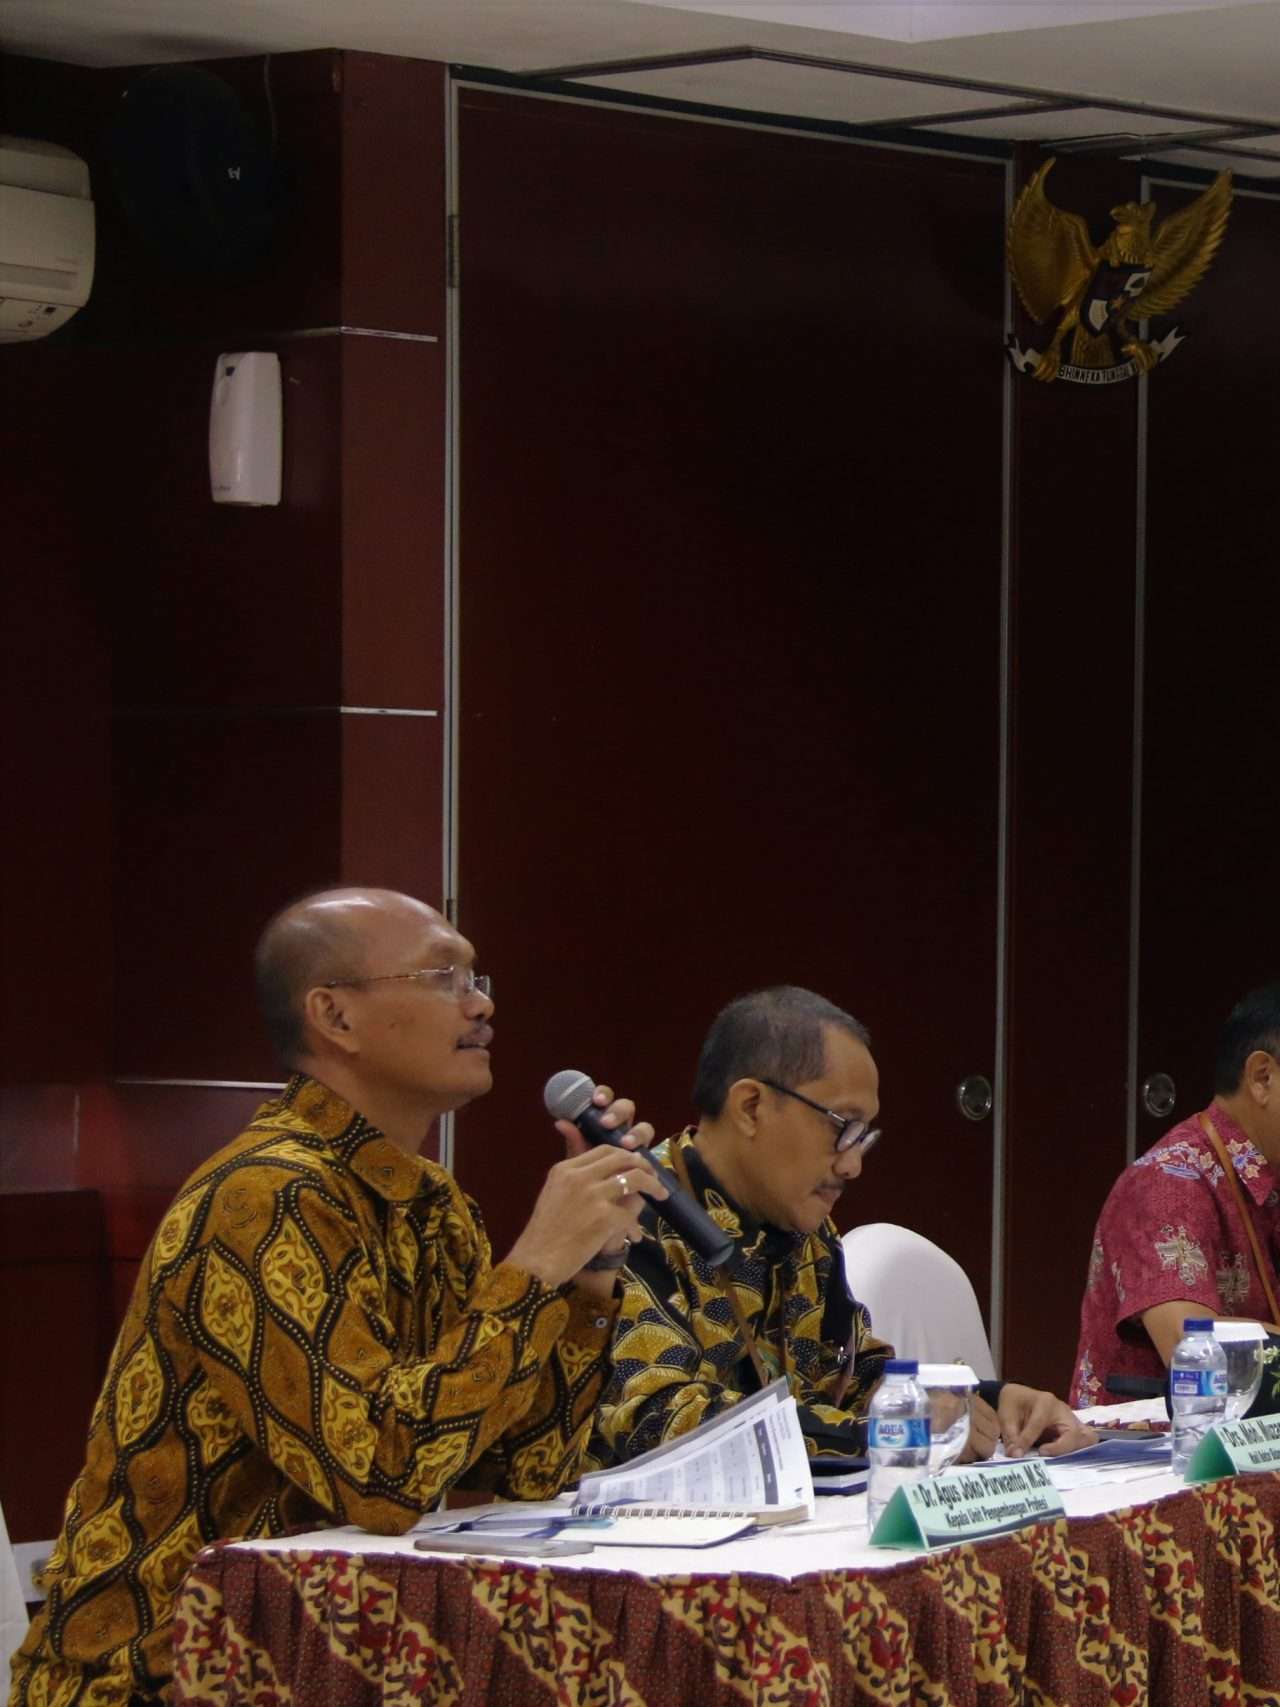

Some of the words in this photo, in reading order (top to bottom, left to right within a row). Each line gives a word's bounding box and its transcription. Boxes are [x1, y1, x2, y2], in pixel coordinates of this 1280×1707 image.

[917, 1483, 937, 1508] Dr.
[934, 1480, 962, 1511] Agus
[960, 1476, 985, 1502] Joko
